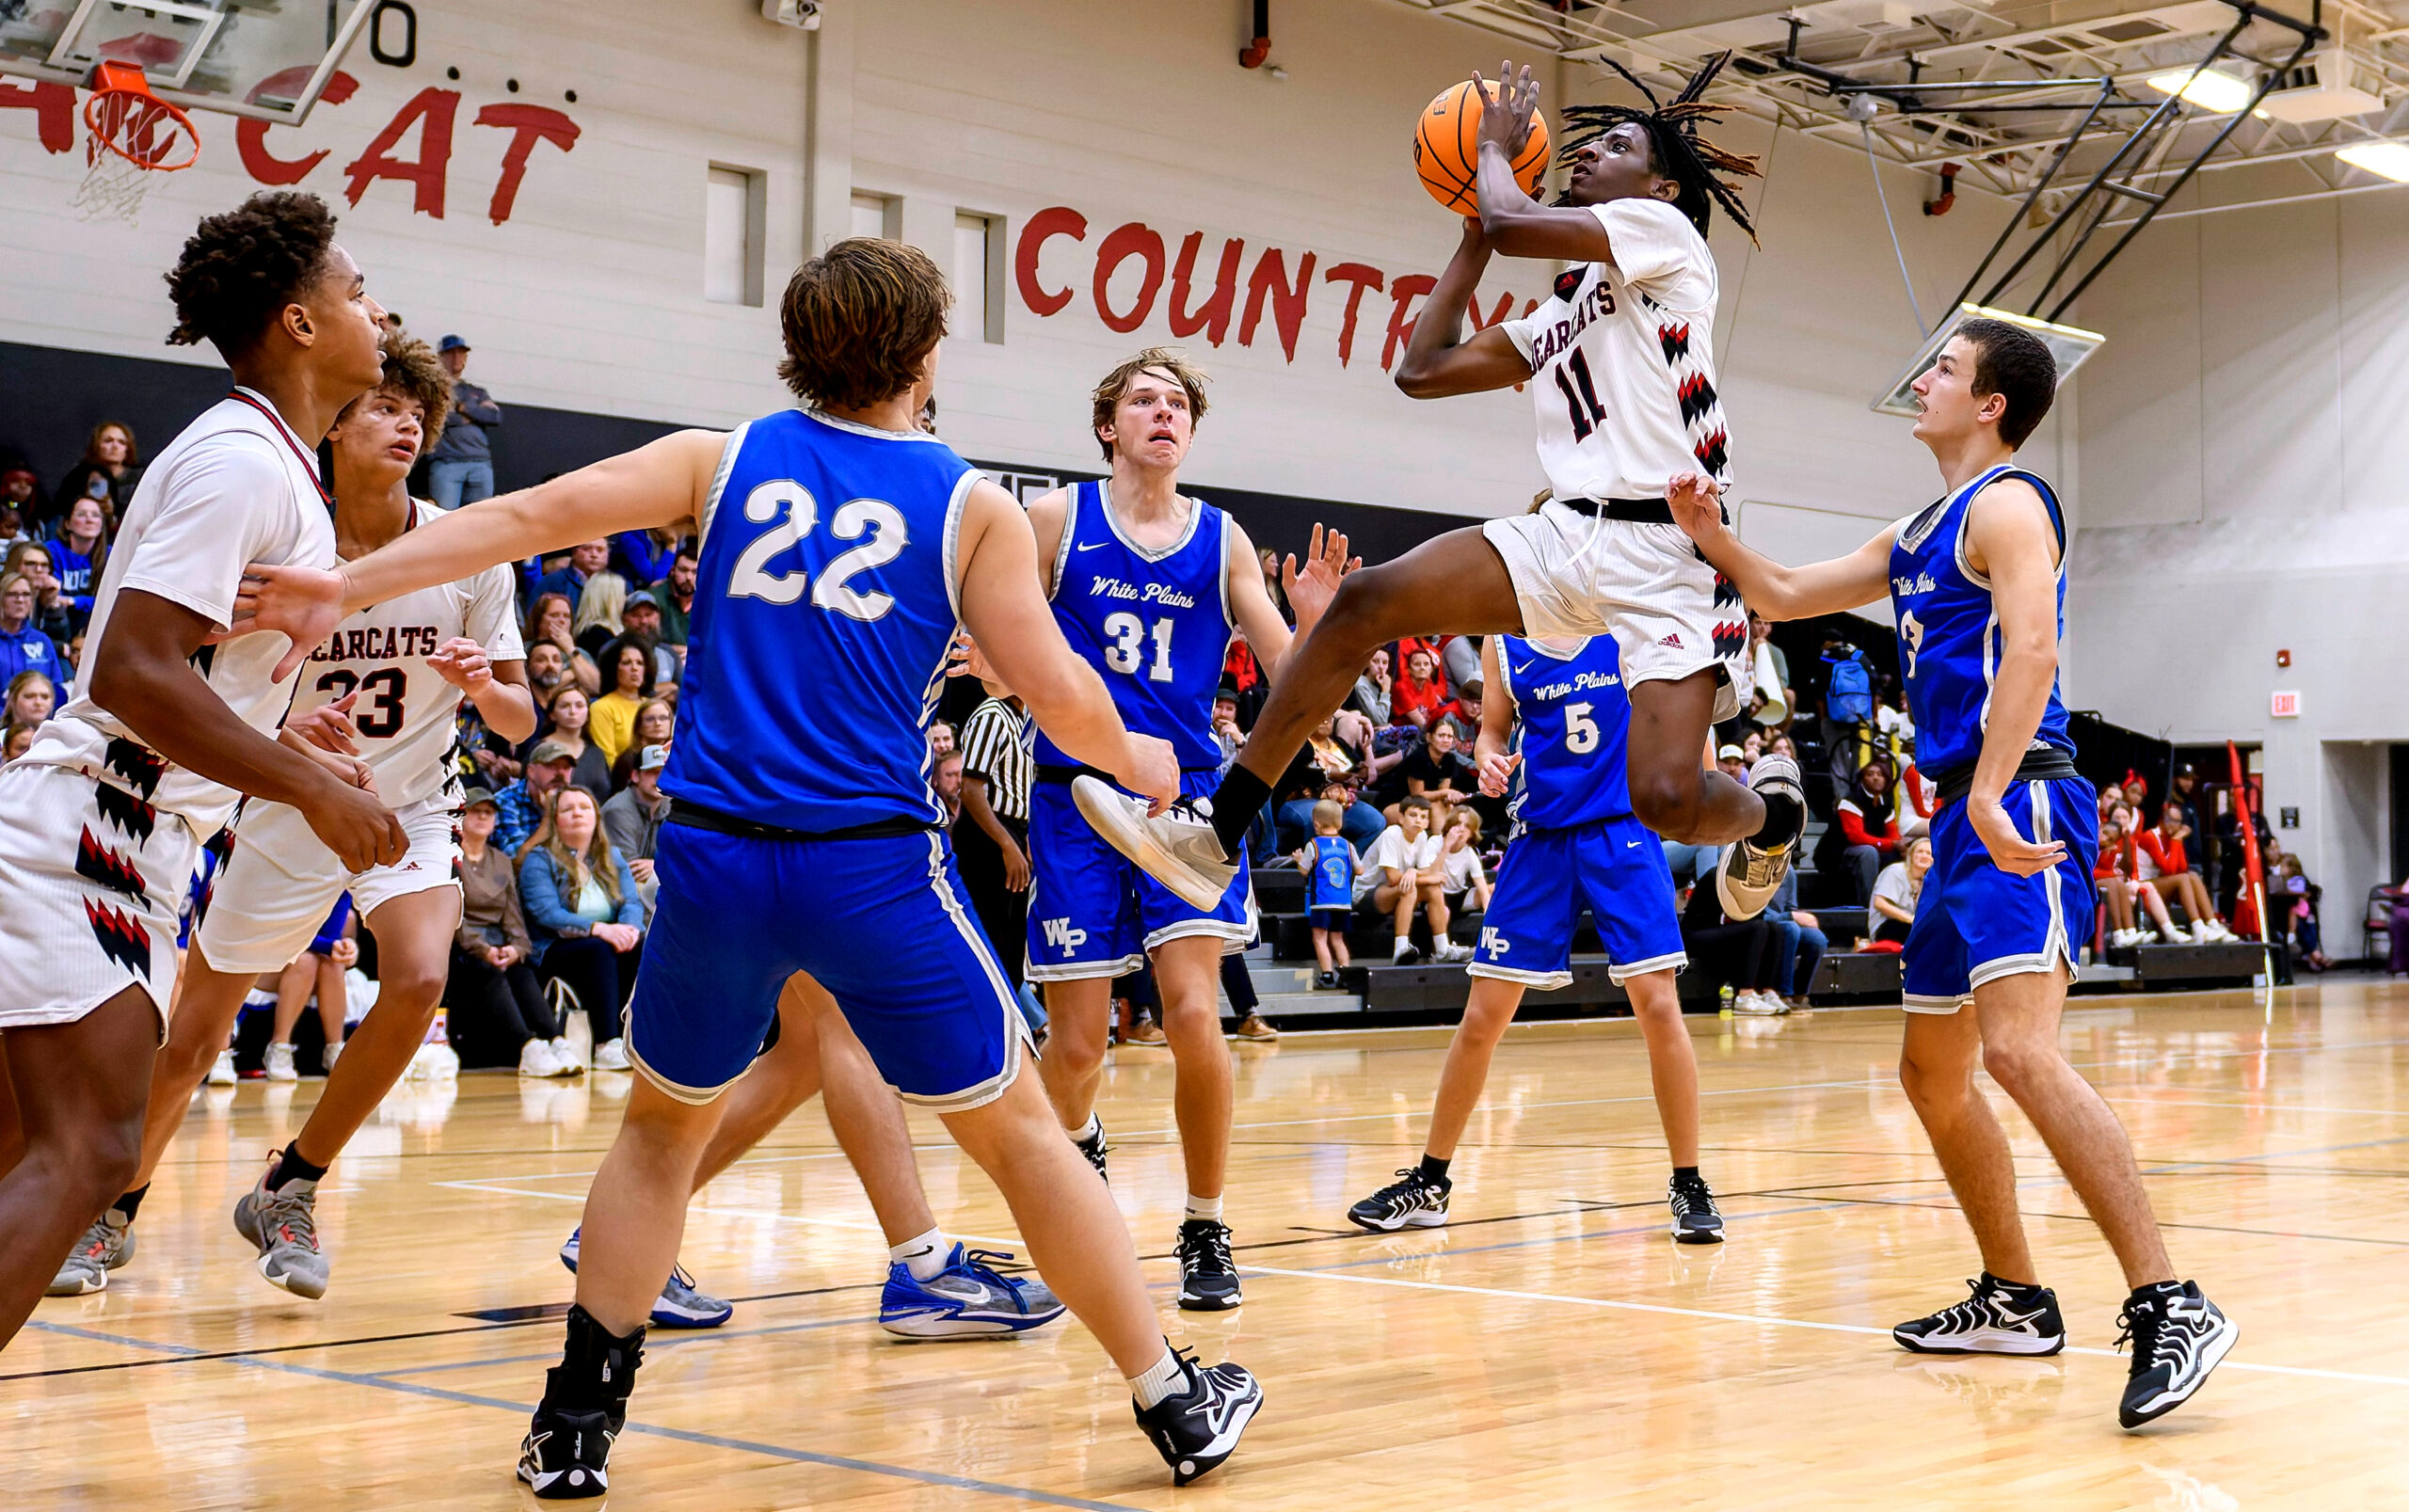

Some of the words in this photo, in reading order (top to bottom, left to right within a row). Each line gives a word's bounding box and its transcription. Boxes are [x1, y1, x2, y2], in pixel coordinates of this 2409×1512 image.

[1530, 280, 1617, 374] EARCATS
[1555, 344, 1608, 445] 11
[726, 479, 912, 623] 22
[1090, 575, 1139, 599] White
[1141, 582, 1194, 609] Plains
[1104, 612, 1175, 683] 31
[1657, 640, 1684, 650] adidas
[1533, 682, 1572, 701] White
[1573, 671, 1619, 692] Plains
[2274, 694, 2295, 712] EXIT
[1565, 701, 1601, 755] 5
